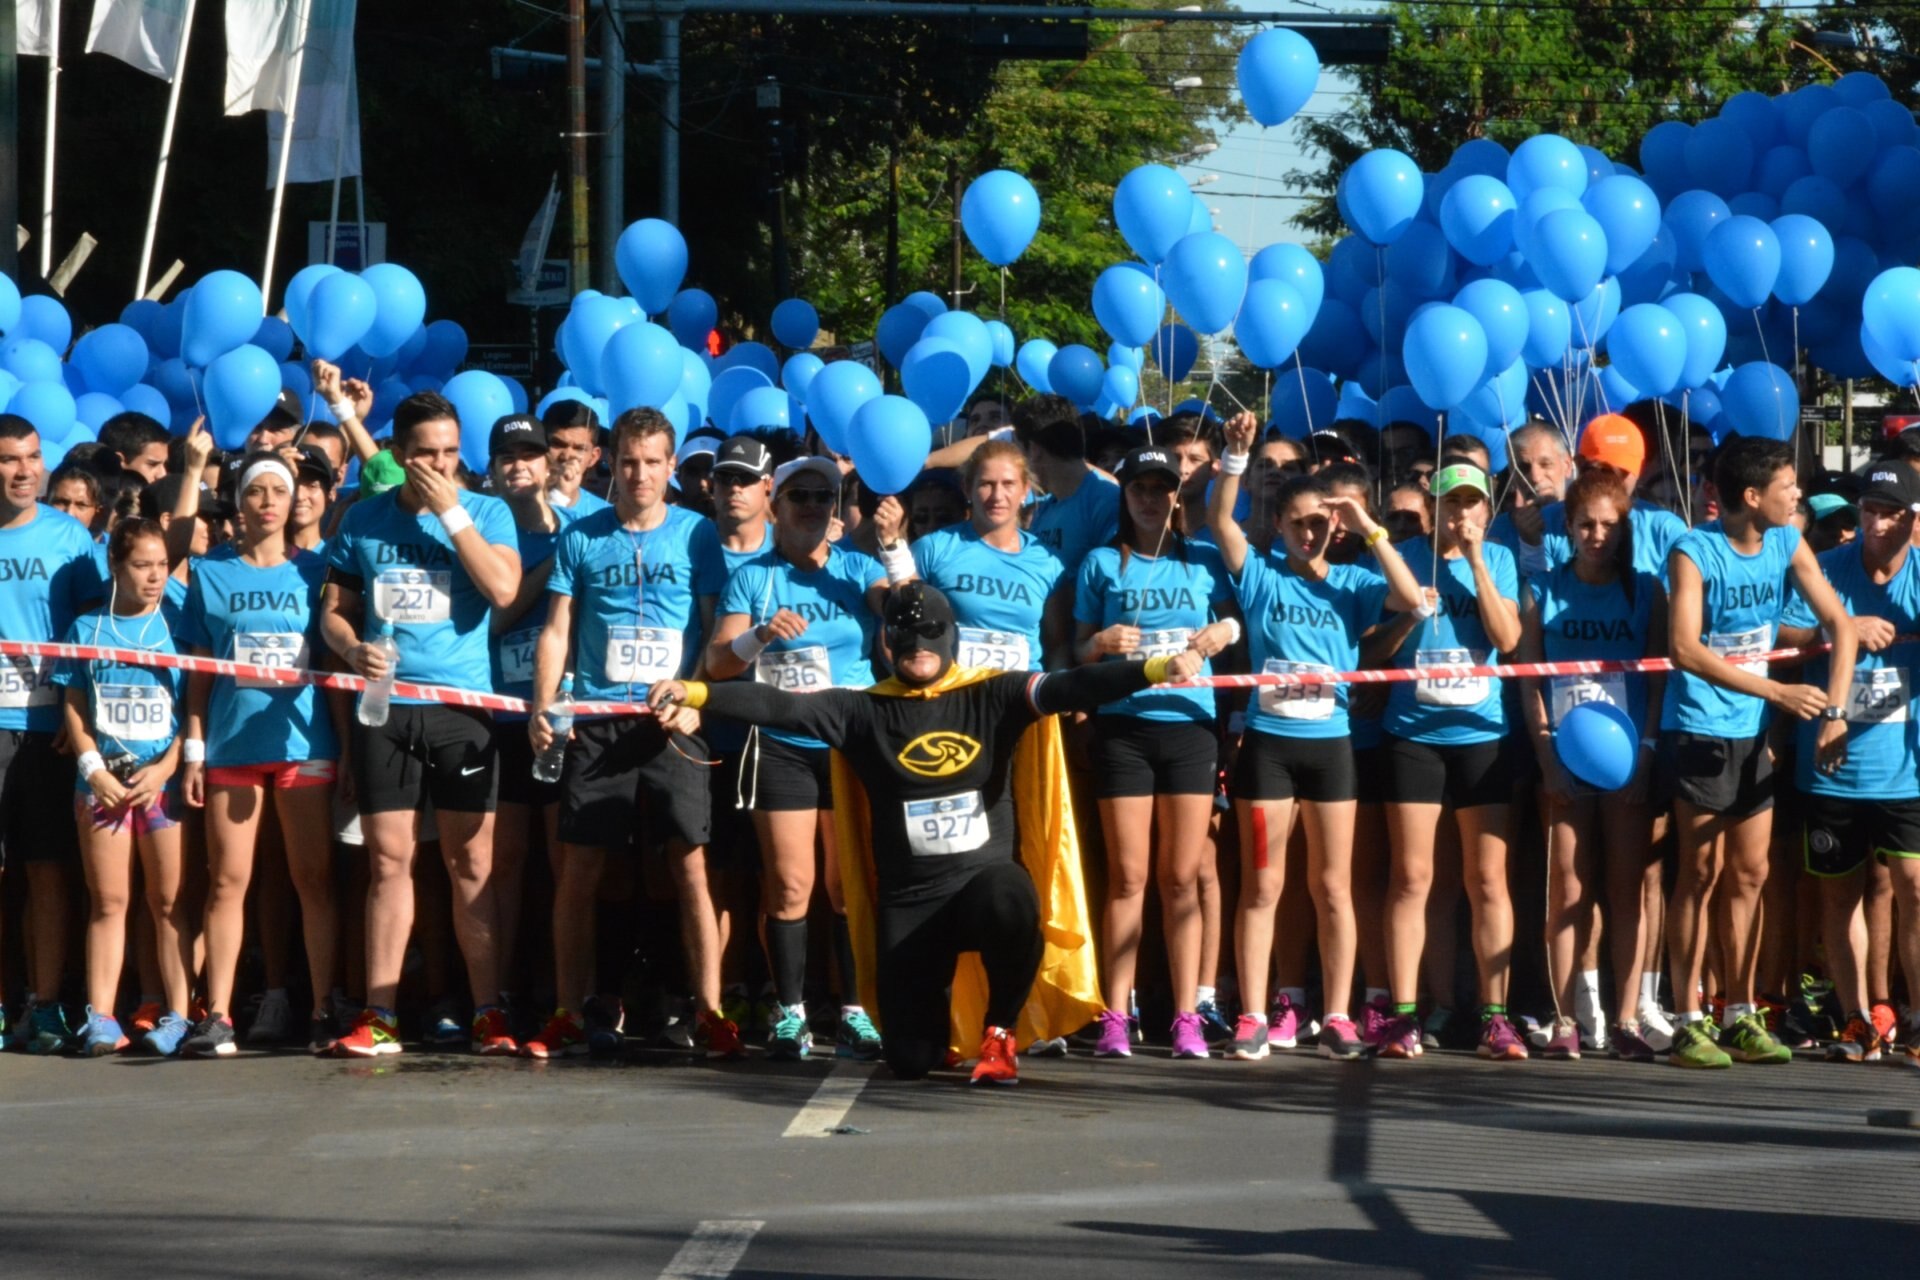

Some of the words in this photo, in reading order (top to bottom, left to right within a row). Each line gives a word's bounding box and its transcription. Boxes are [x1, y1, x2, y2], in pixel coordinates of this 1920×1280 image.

[503, 420, 533, 433] BBVA
[1138, 451, 1168, 464] BBVA
[1871, 471, 1898, 484] BBVA
[375, 543, 452, 565] BBVA
[0, 557, 49, 581] BVA
[603, 563, 677, 587] BBVA
[391, 588, 433, 609] 221
[956, 574, 1032, 606] BBVA
[1121, 588, 1196, 612] BBVA
[1726, 582, 1775, 610] BBVA
[229, 591, 301, 615] BBVA
[778, 601, 854, 624] BVA
[1271, 602, 1339, 630] BBVA
[1562, 619, 1635, 641] BBVA
[620, 645, 670, 668] 902
[966, 647, 1022, 671] 1232
[0, 670, 53, 693] 584
[770, 664, 818, 689] 736
[1855, 688, 1901, 709] 495
[104, 702, 164, 724] 1008
[923, 814, 972, 841] 927
